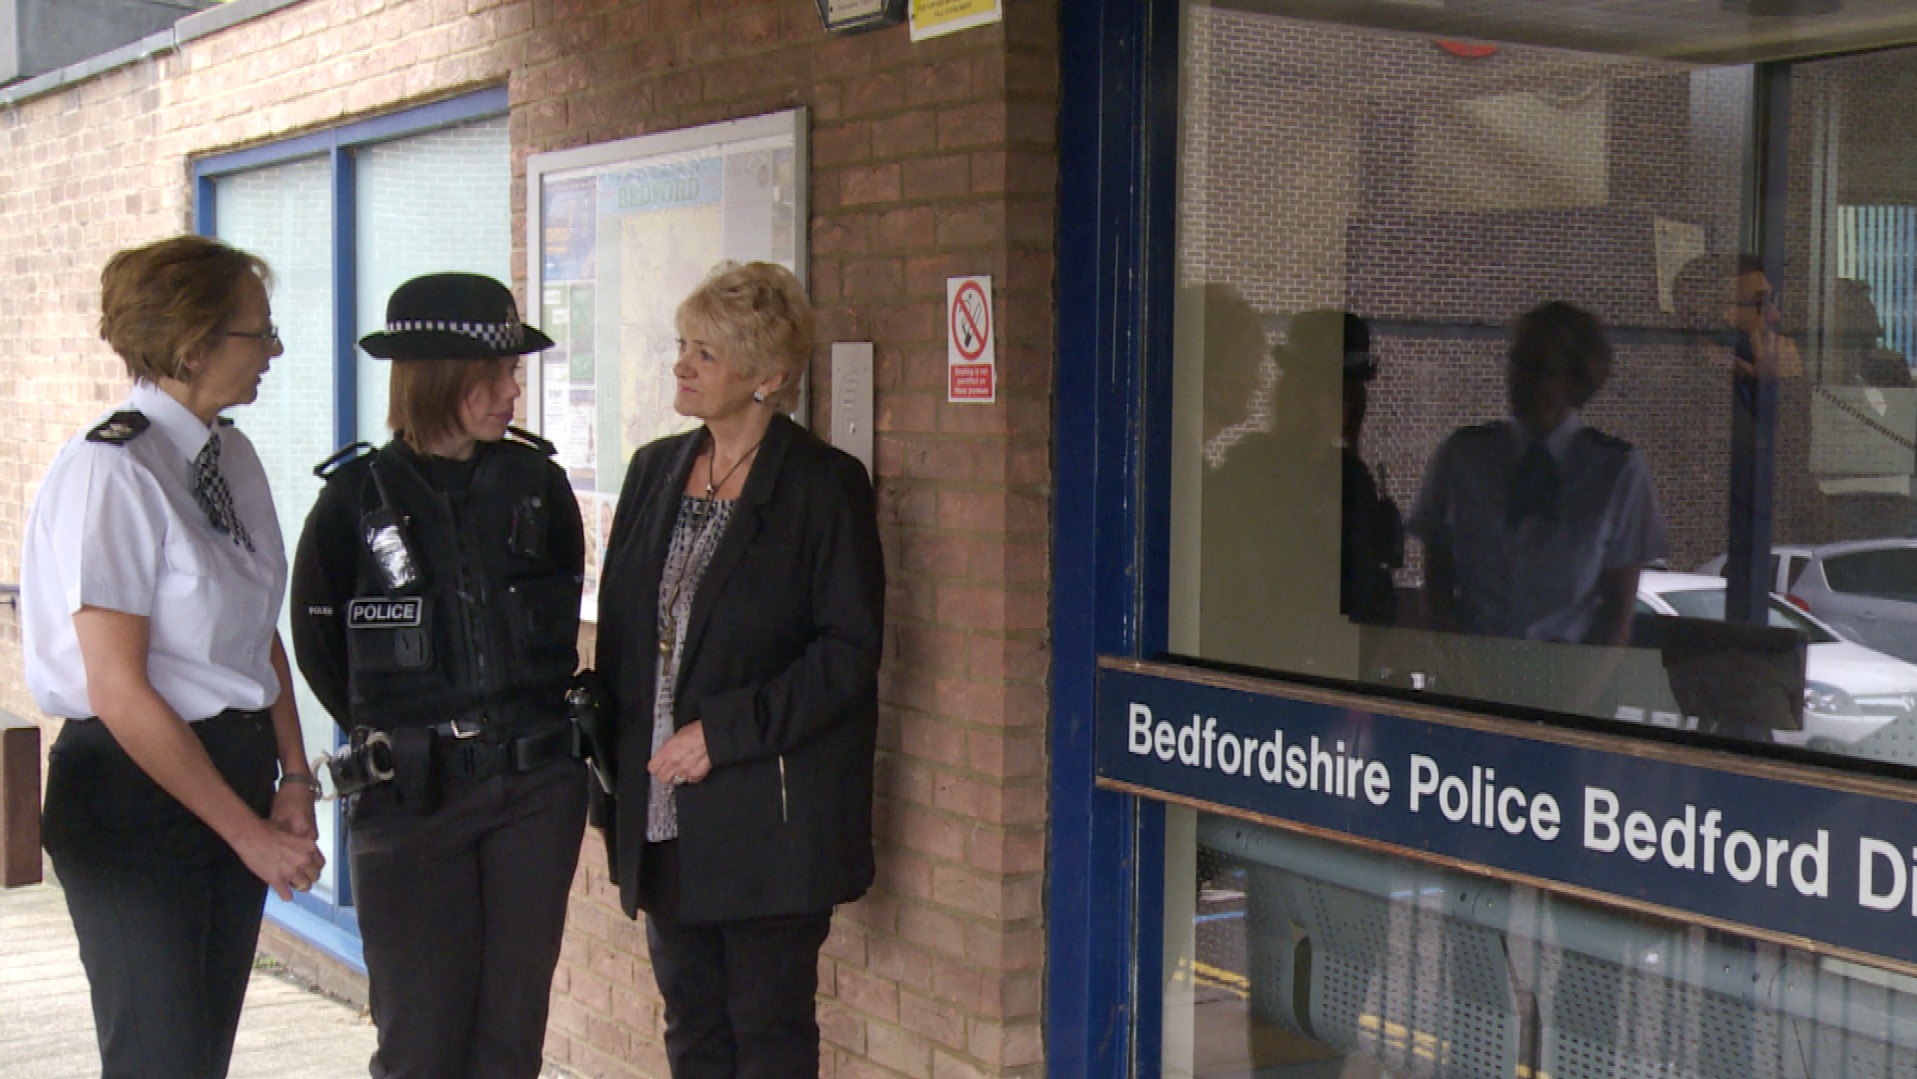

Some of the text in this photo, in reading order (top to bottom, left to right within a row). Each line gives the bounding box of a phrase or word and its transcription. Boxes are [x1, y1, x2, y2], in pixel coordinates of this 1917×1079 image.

[618, 177, 701, 208] BEDFORD
[353, 603, 415, 620] POLICE
[1128, 701, 1391, 805] Bedfordshire
[1409, 754, 1561, 841] Police
[1583, 786, 1830, 899] Bedford
